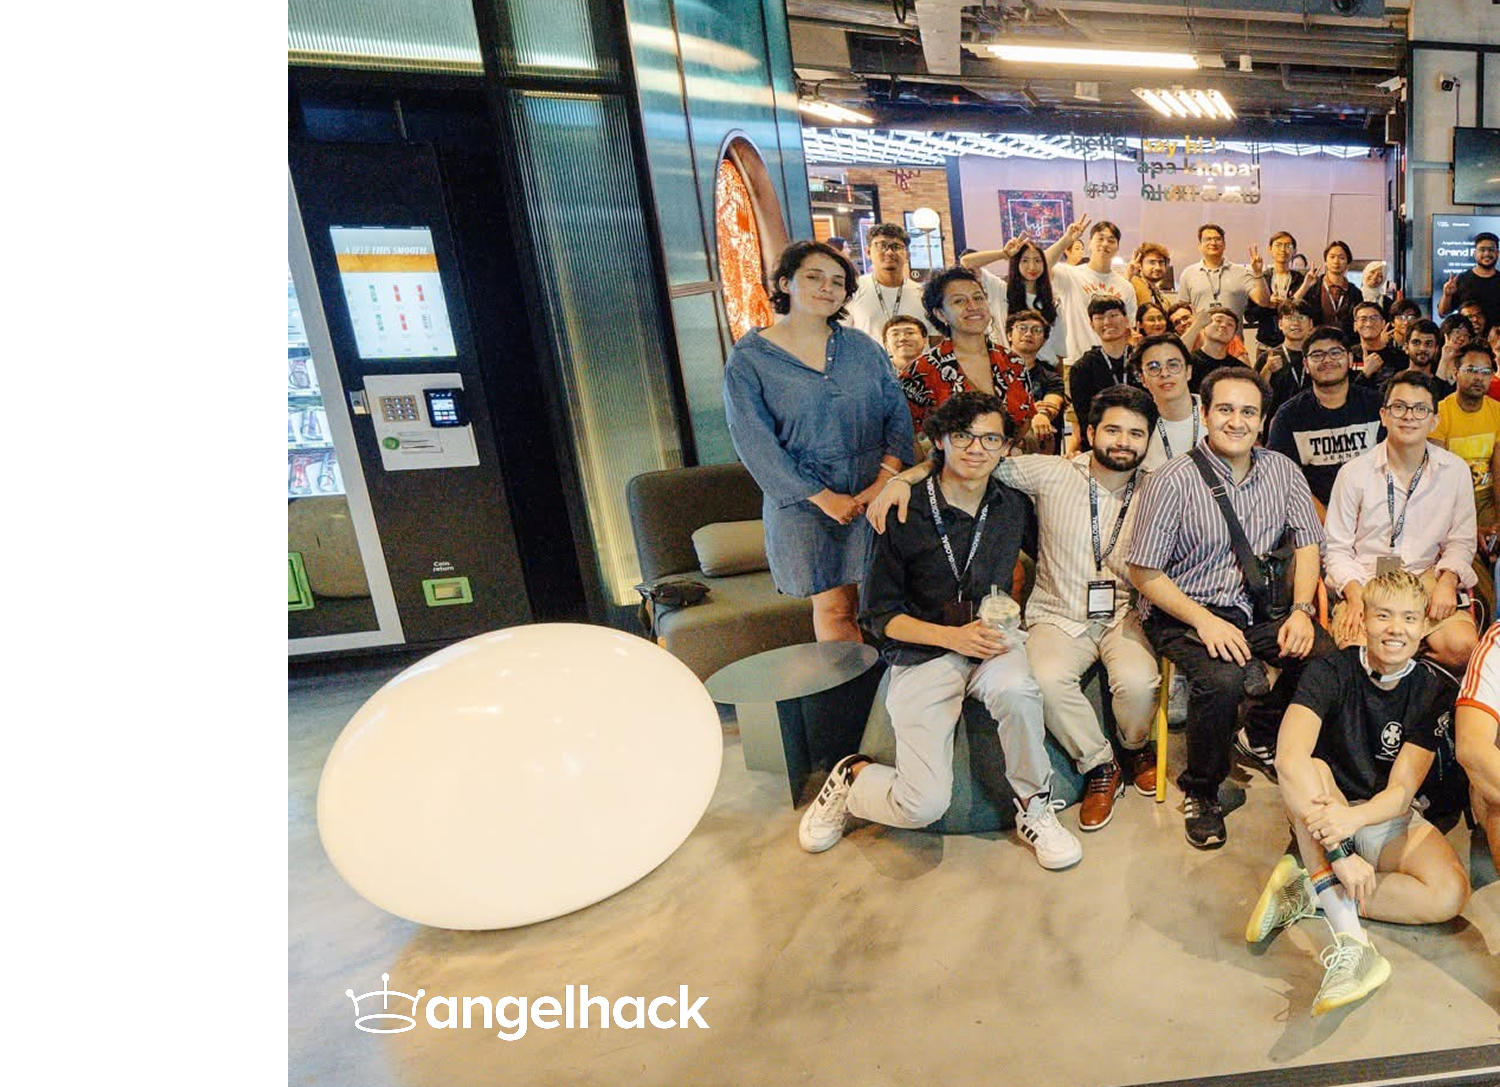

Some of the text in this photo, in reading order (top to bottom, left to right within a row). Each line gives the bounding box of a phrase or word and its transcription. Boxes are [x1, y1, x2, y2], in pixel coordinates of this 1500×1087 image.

[1070, 132, 1127, 150] hello
[1143, 139, 1178, 157] say
[1185, 135, 1203, 154] hi
[1137, 161, 1177, 179] apa
[371, 246, 391, 254] THIS
[393, 245, 427, 254] SMOOTH
[1437, 248, 1469, 257] Grand
[1310, 431, 1367, 456] TOMMY
[1323, 452, 1361, 461] JEANS
